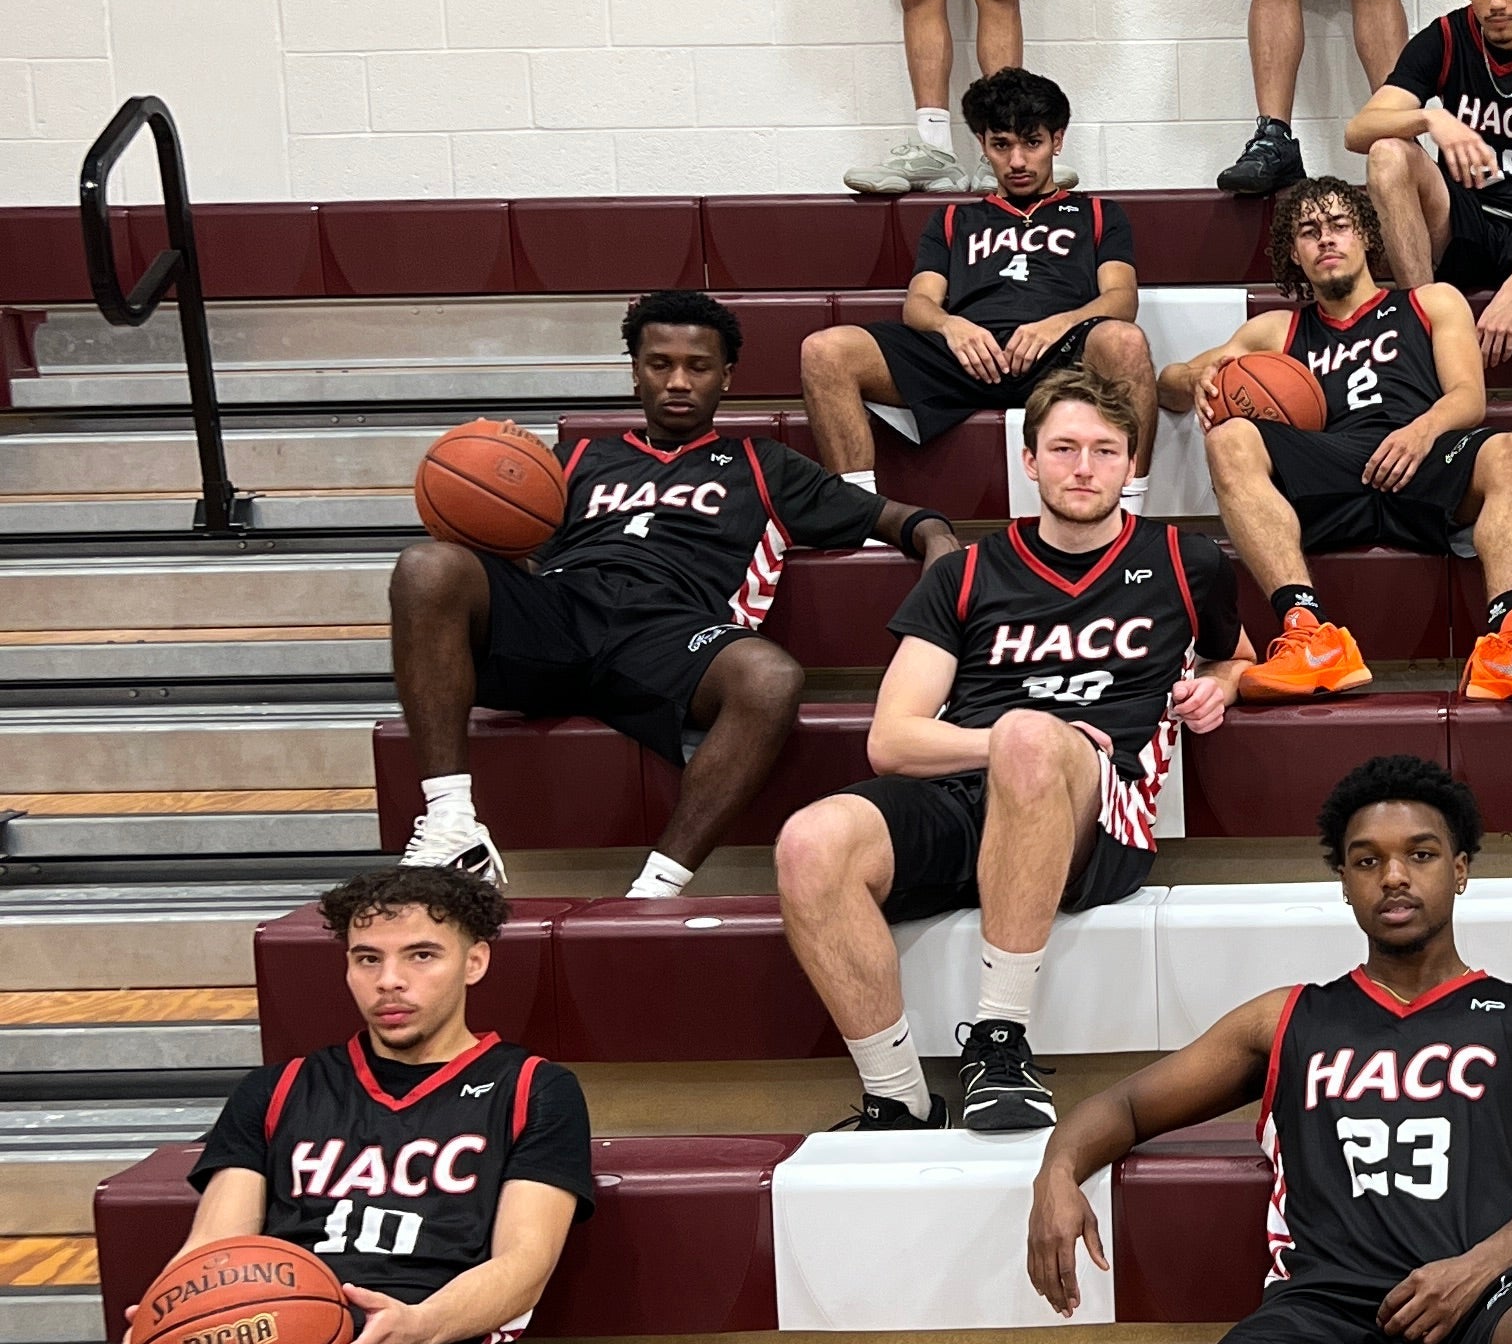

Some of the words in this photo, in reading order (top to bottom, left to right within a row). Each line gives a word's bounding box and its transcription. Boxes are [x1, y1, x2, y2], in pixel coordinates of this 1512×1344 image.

[968, 225, 1076, 266] HACC
[999, 254, 1029, 281] 4
[1347, 366, 1383, 411] 2
[584, 480, 727, 520] HACC
[1125, 569, 1153, 585] MP
[988, 617, 1154, 666] HACC
[1304, 1042, 1497, 1111] HACC
[290, 1133, 488, 1199] HACC
[1336, 1116, 1451, 1200] 23
[313, 1199, 424, 1255] 10
[151, 1262, 296, 1325] SPALDING
